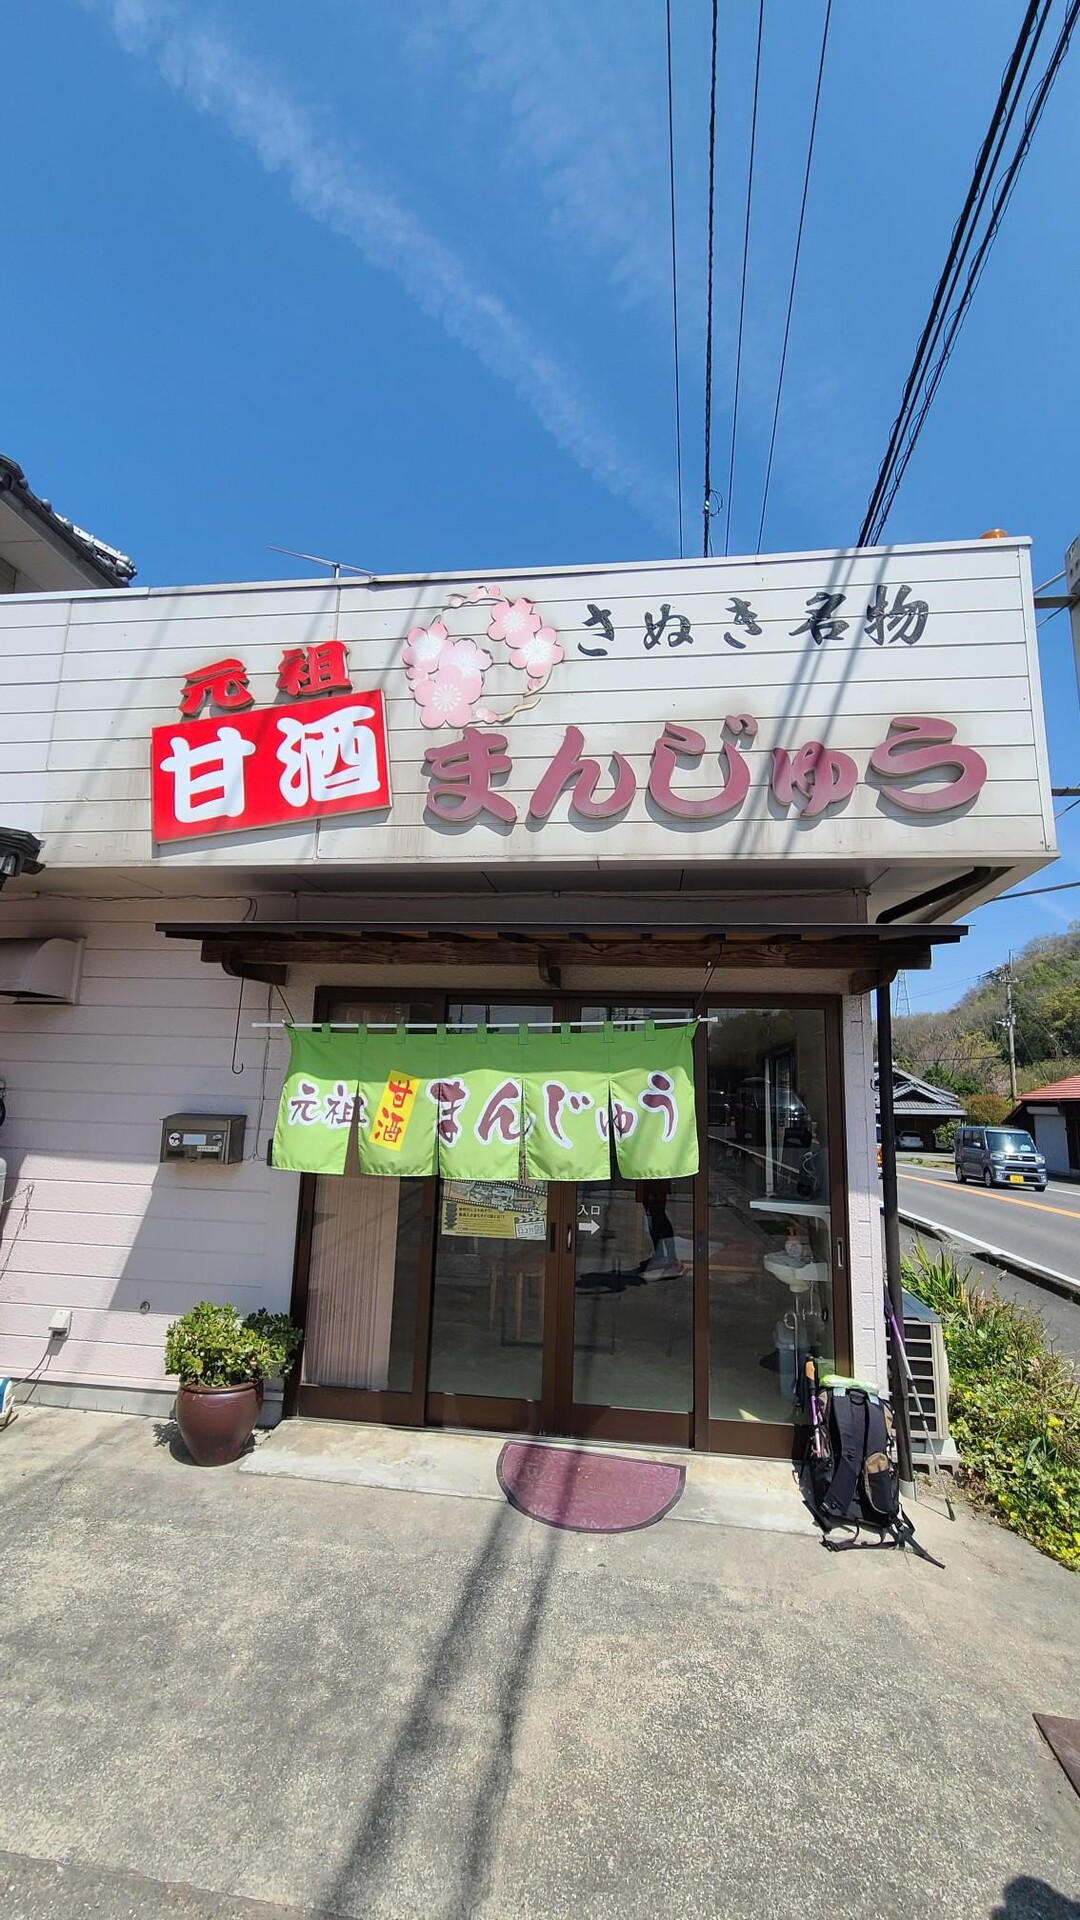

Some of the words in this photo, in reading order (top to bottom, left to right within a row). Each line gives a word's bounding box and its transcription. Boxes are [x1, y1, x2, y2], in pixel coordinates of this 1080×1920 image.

[578, 584, 929, 656] さぬき名物
[178, 640, 354, 717] 元祖
[160, 705, 381, 824] 甘酒
[423, 714, 988, 824] まんじゅう
[290, 1082, 367, 1125] 元祖
[374, 1080, 413, 1143] 甘酒
[429, 1074, 676, 1143] まんじゅう
[578, 1204, 600, 1216] 入口
